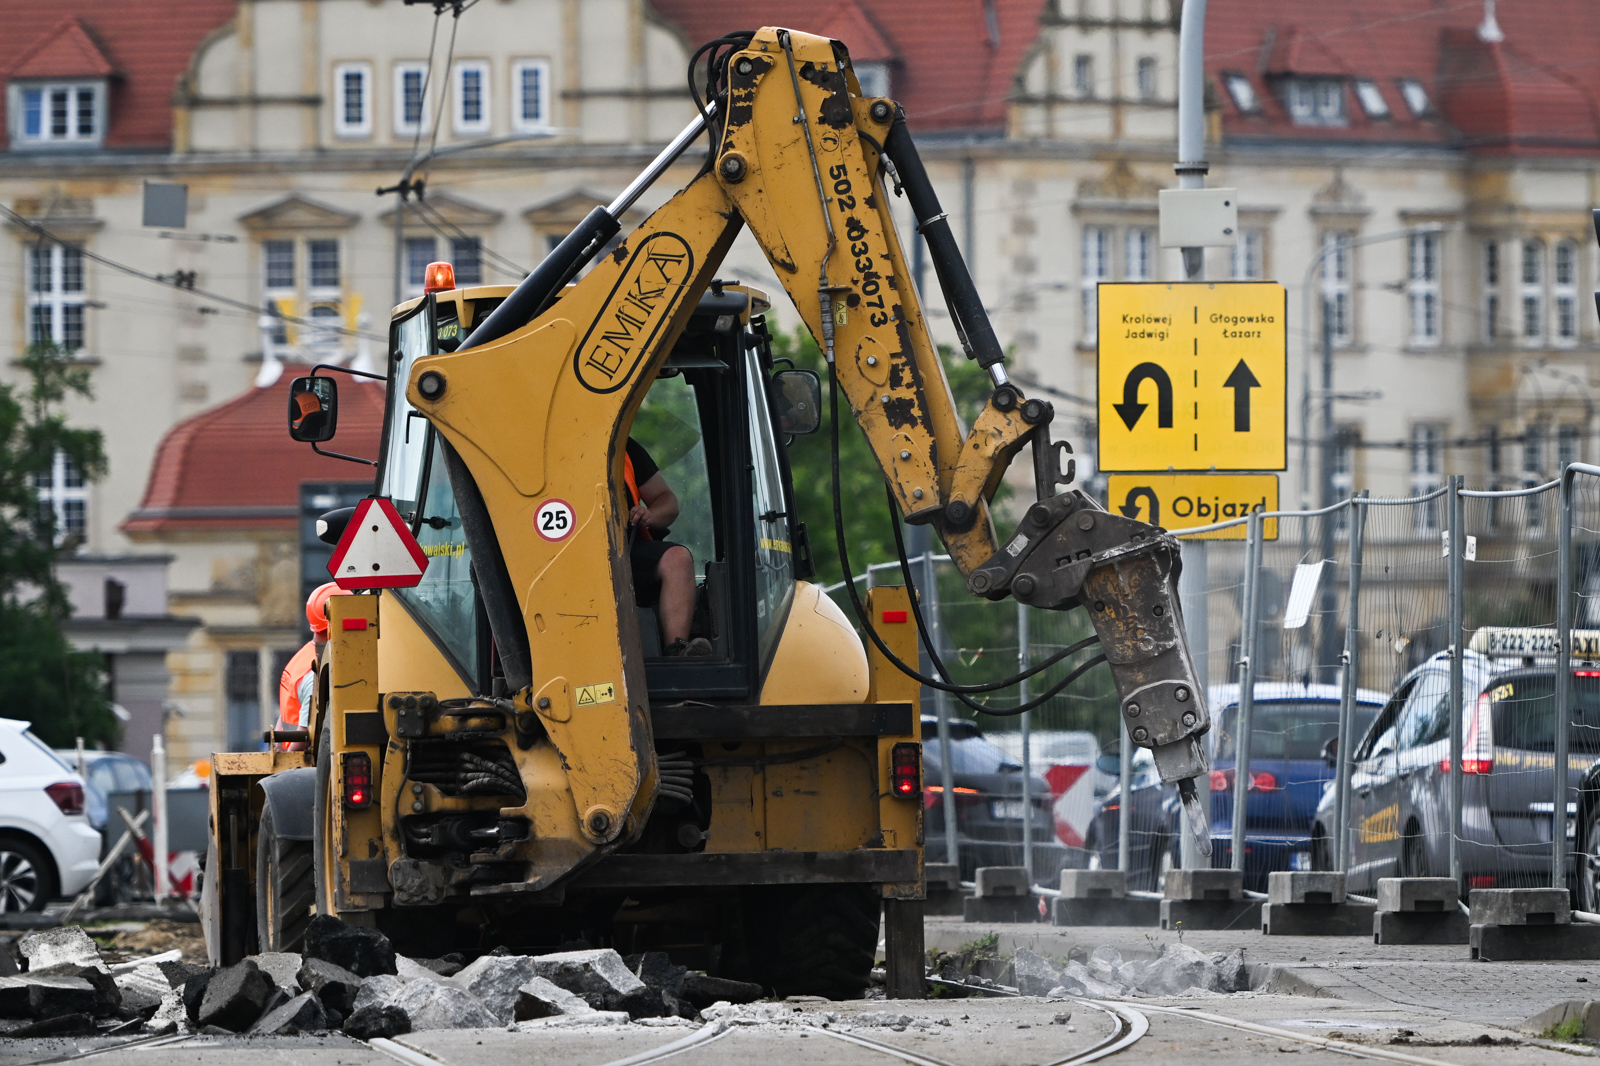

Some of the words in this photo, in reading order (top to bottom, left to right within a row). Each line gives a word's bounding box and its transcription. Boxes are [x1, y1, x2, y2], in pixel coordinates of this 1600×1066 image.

[829, 163, 857, 213] 502
[846, 223, 874, 274] 033
[861, 279, 889, 328] 073
[585, 252, 687, 382] EMKA
[1209, 313, 1275, 326] Głogowska
[443, 324, 458, 338] 073
[1125, 328, 1170, 341] Jadwigi
[1222, 328, 1262, 339] Łazarz
[541, 510, 568, 531] 25
